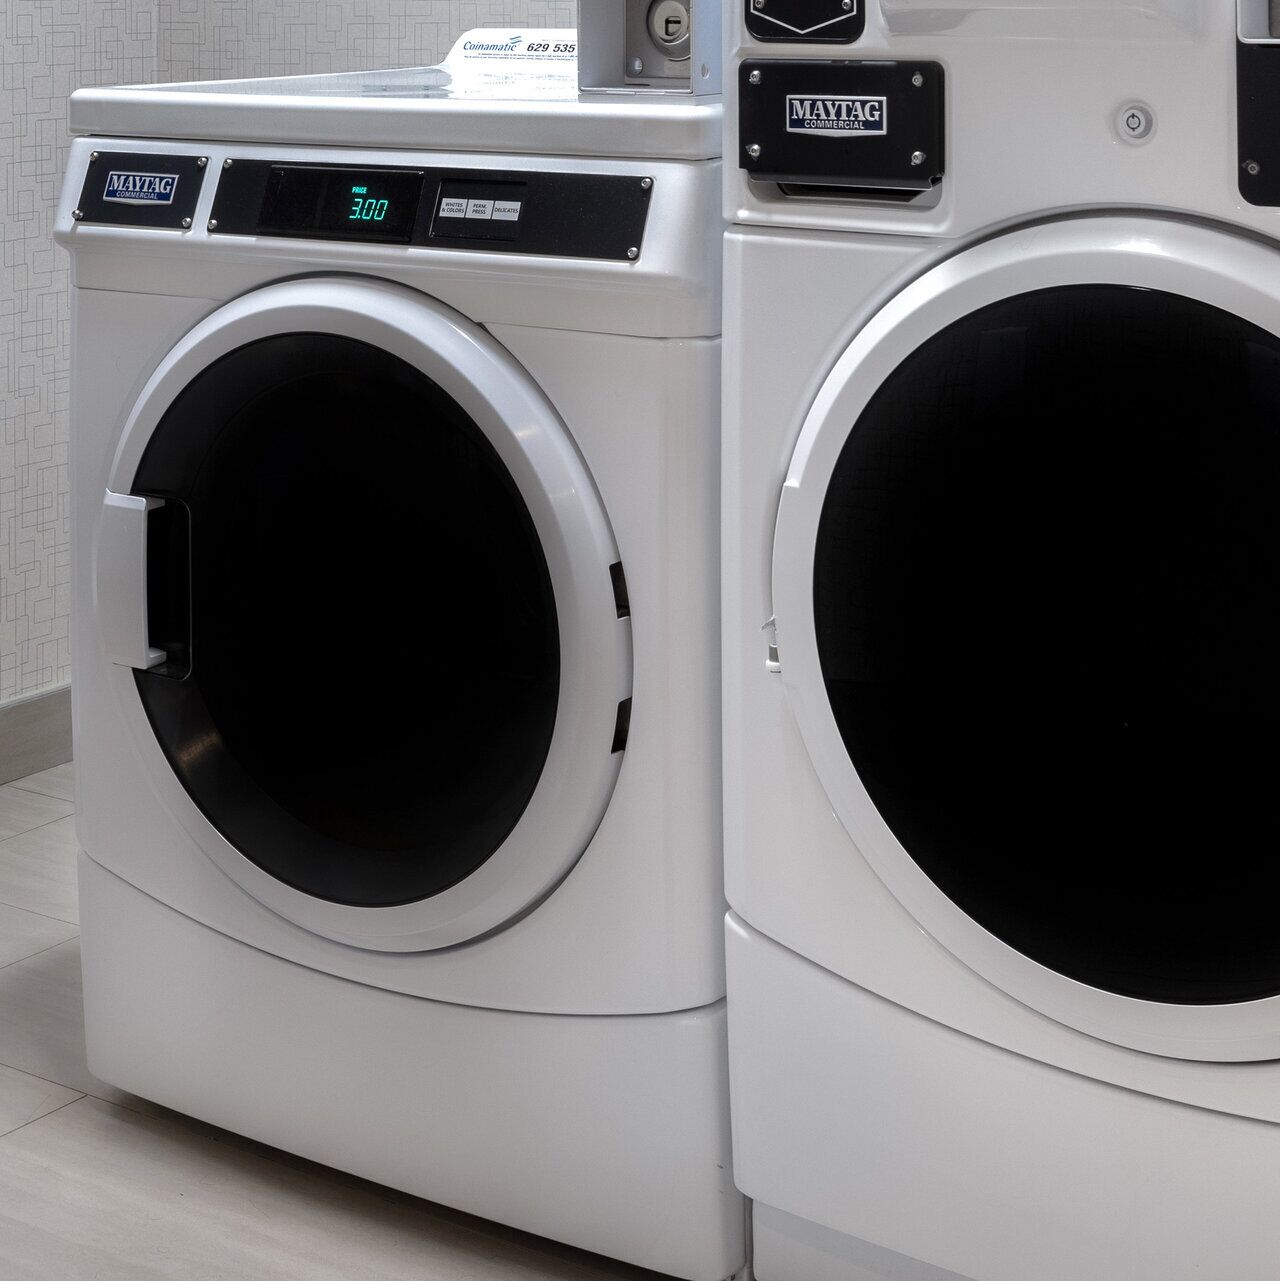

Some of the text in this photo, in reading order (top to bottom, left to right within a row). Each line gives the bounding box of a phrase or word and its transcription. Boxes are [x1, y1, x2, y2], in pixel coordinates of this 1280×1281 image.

[463, 41, 517, 51] Coinamatic
[527, 43, 576, 53] 629 535
[791, 100, 881, 121] MAYTAG
[804, 120, 865, 129] COMMERCIAL
[109, 175, 172, 193] MAYTAG
[352, 186, 368, 194] PRICE
[116, 191, 158, 200] COMMERCIAL
[349, 198, 388, 220] 3.00
